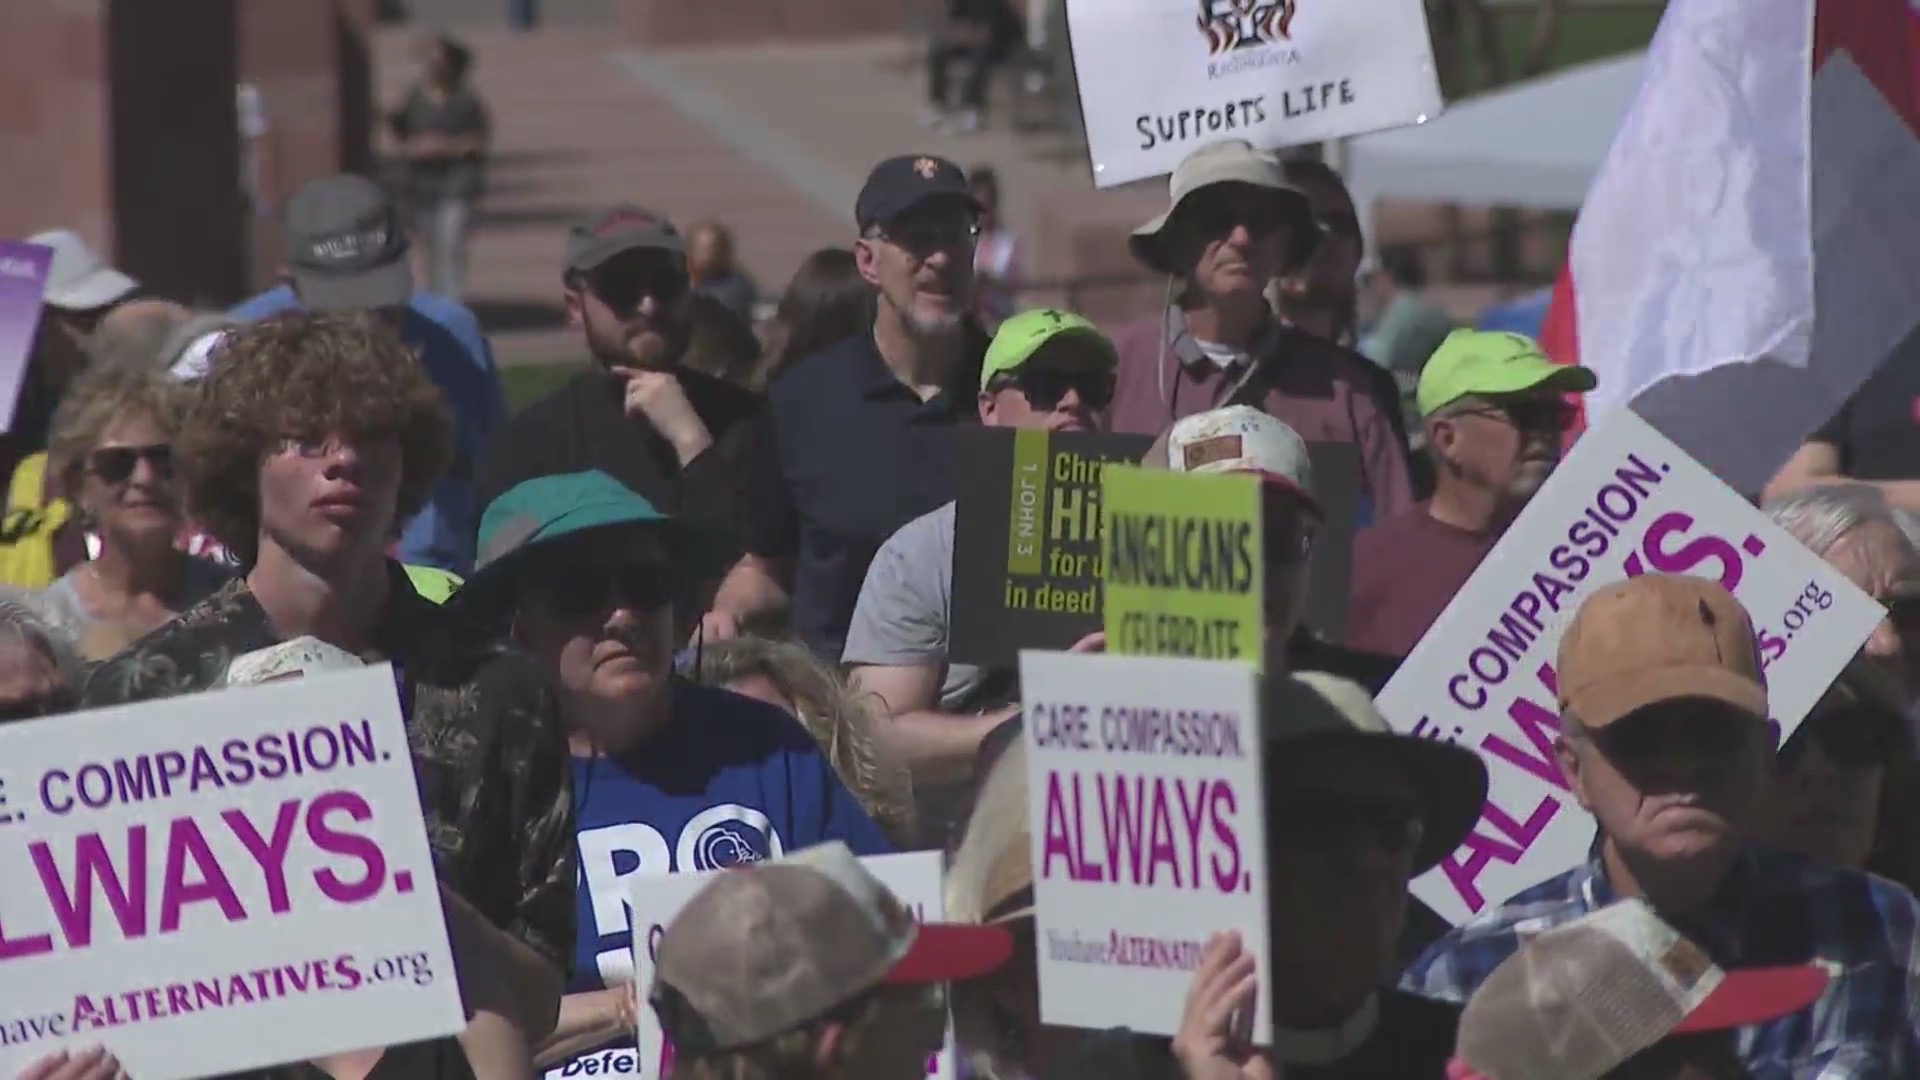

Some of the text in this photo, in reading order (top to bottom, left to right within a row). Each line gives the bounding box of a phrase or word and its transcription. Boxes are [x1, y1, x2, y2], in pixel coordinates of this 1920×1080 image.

[1136, 79, 1355, 150] SUPPORTS LIFE
[1018, 478, 1036, 538] JOHN
[1051, 487, 1105, 541] Hi
[1017, 543, 1033, 555] 3
[1050, 549, 1087, 577] for
[1109, 513, 1253, 595] ANGLICANS
[1005, 580, 1096, 614] in deed
[1449, 452, 1672, 711] COMPASSION.
[1101, 706, 1246, 758] COMPASSION.
[39, 719, 391, 816] COMPASSION.
[1042, 769, 1252, 893] ALWAYS.
